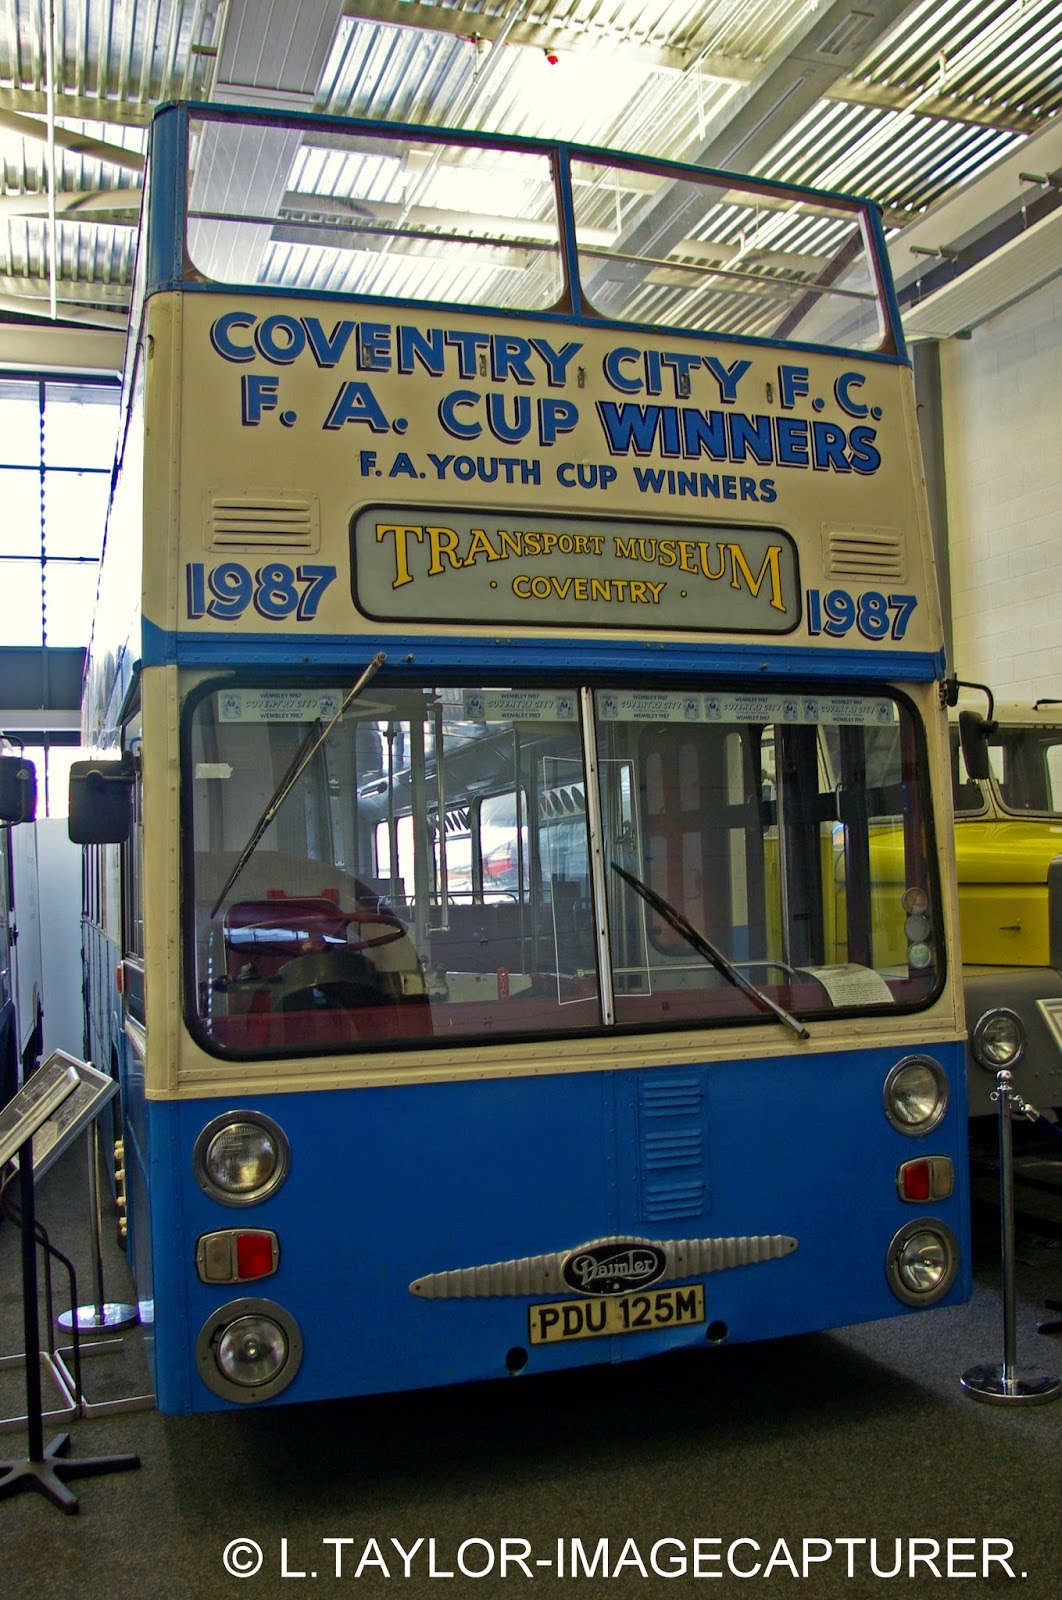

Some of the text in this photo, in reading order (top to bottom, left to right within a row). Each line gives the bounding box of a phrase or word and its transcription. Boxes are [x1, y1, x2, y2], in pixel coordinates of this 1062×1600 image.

[209, 311, 583, 388] COVENTRY
[602, 346, 753, 405] CITY
[437, 389, 580, 448] CUP
[595, 400, 882, 476] WINNERS
[556, 462, 618, 490] CUP
[632, 467, 778, 503] WINNERS
[185, 562, 338, 622] 1987
[375, 523, 788, 615] TRANSPORT MUSEUM
[511, 575, 668, 604] COVENTRY
[805, 588, 919, 641] 1987
[572, 1250, 658, 1286] Daimler
[538, 1289, 697, 1339] PDU 125M
